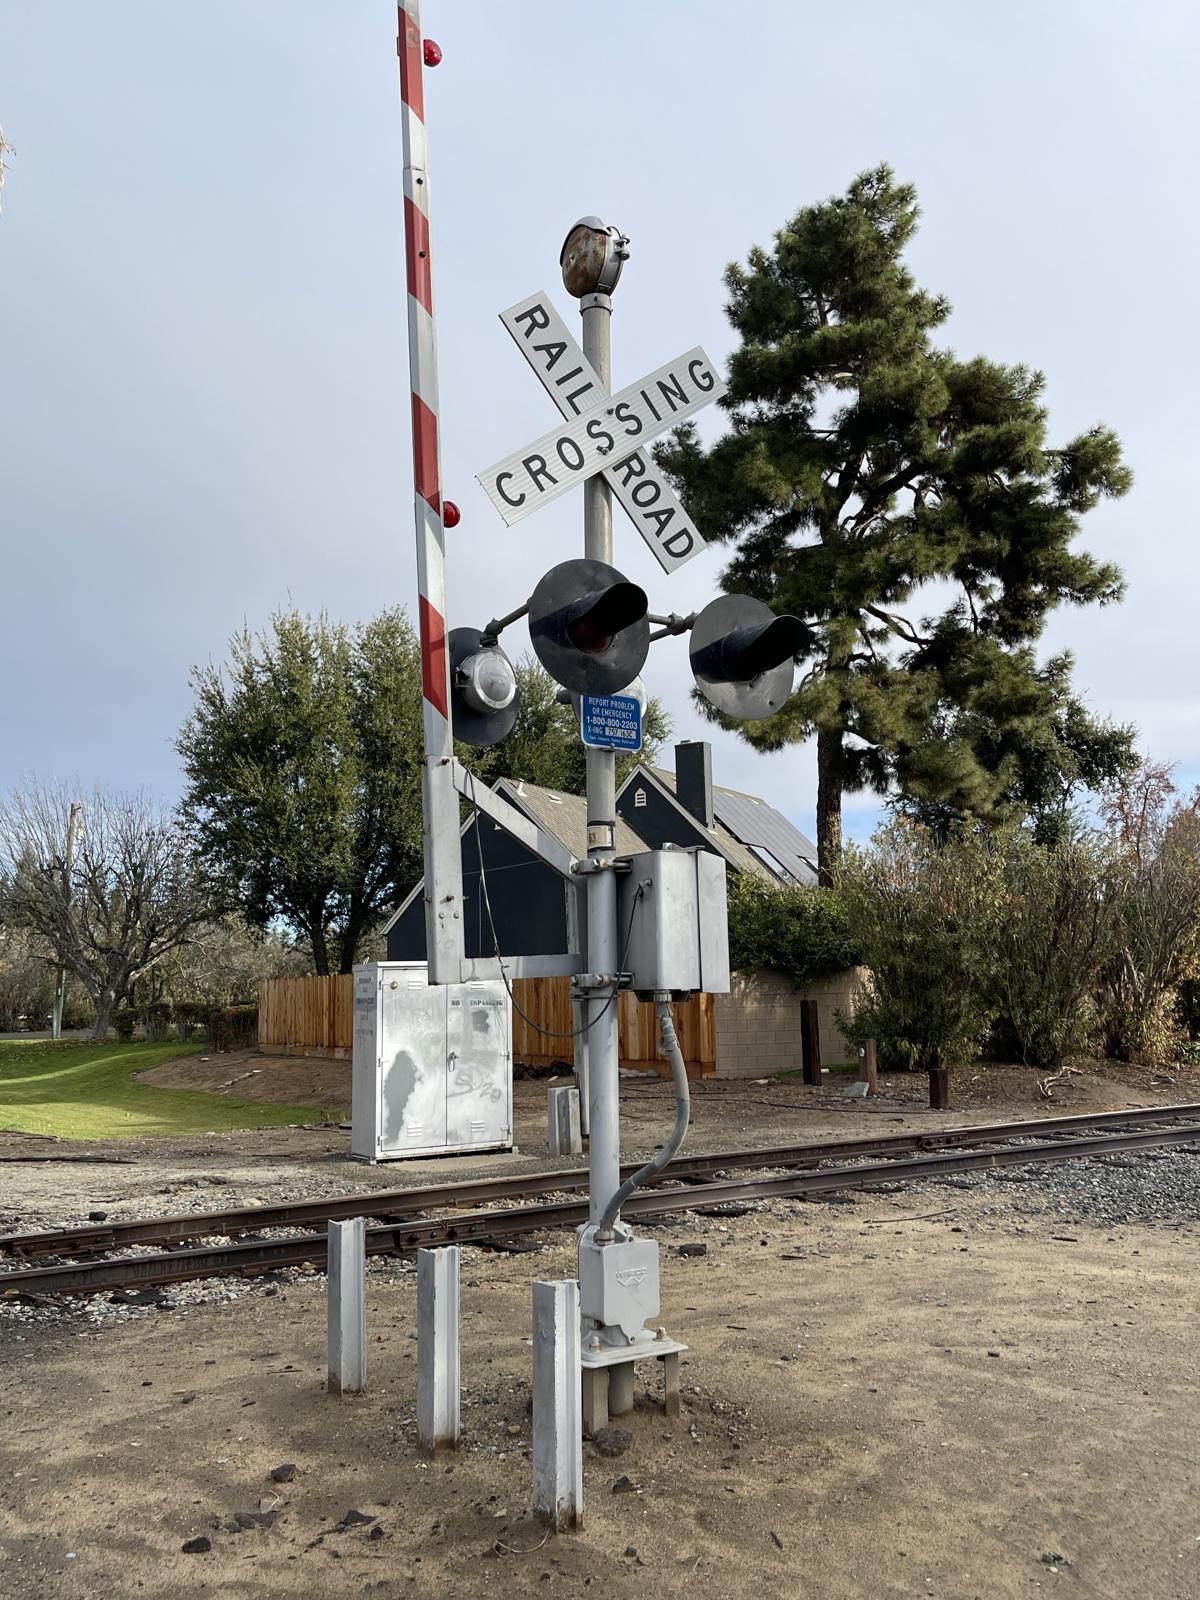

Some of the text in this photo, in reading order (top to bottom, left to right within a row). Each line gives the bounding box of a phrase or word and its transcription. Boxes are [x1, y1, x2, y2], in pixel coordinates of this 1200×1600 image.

[495, 359, 715, 507] CROSSING
[514, 303, 694, 559] RAIL ROAD
[588, 697, 634, 710] REPORT PROBLEM
[592, 707, 632, 719] OR EMERGENCY
[587, 716, 638, 729] 1-800-800-2203
